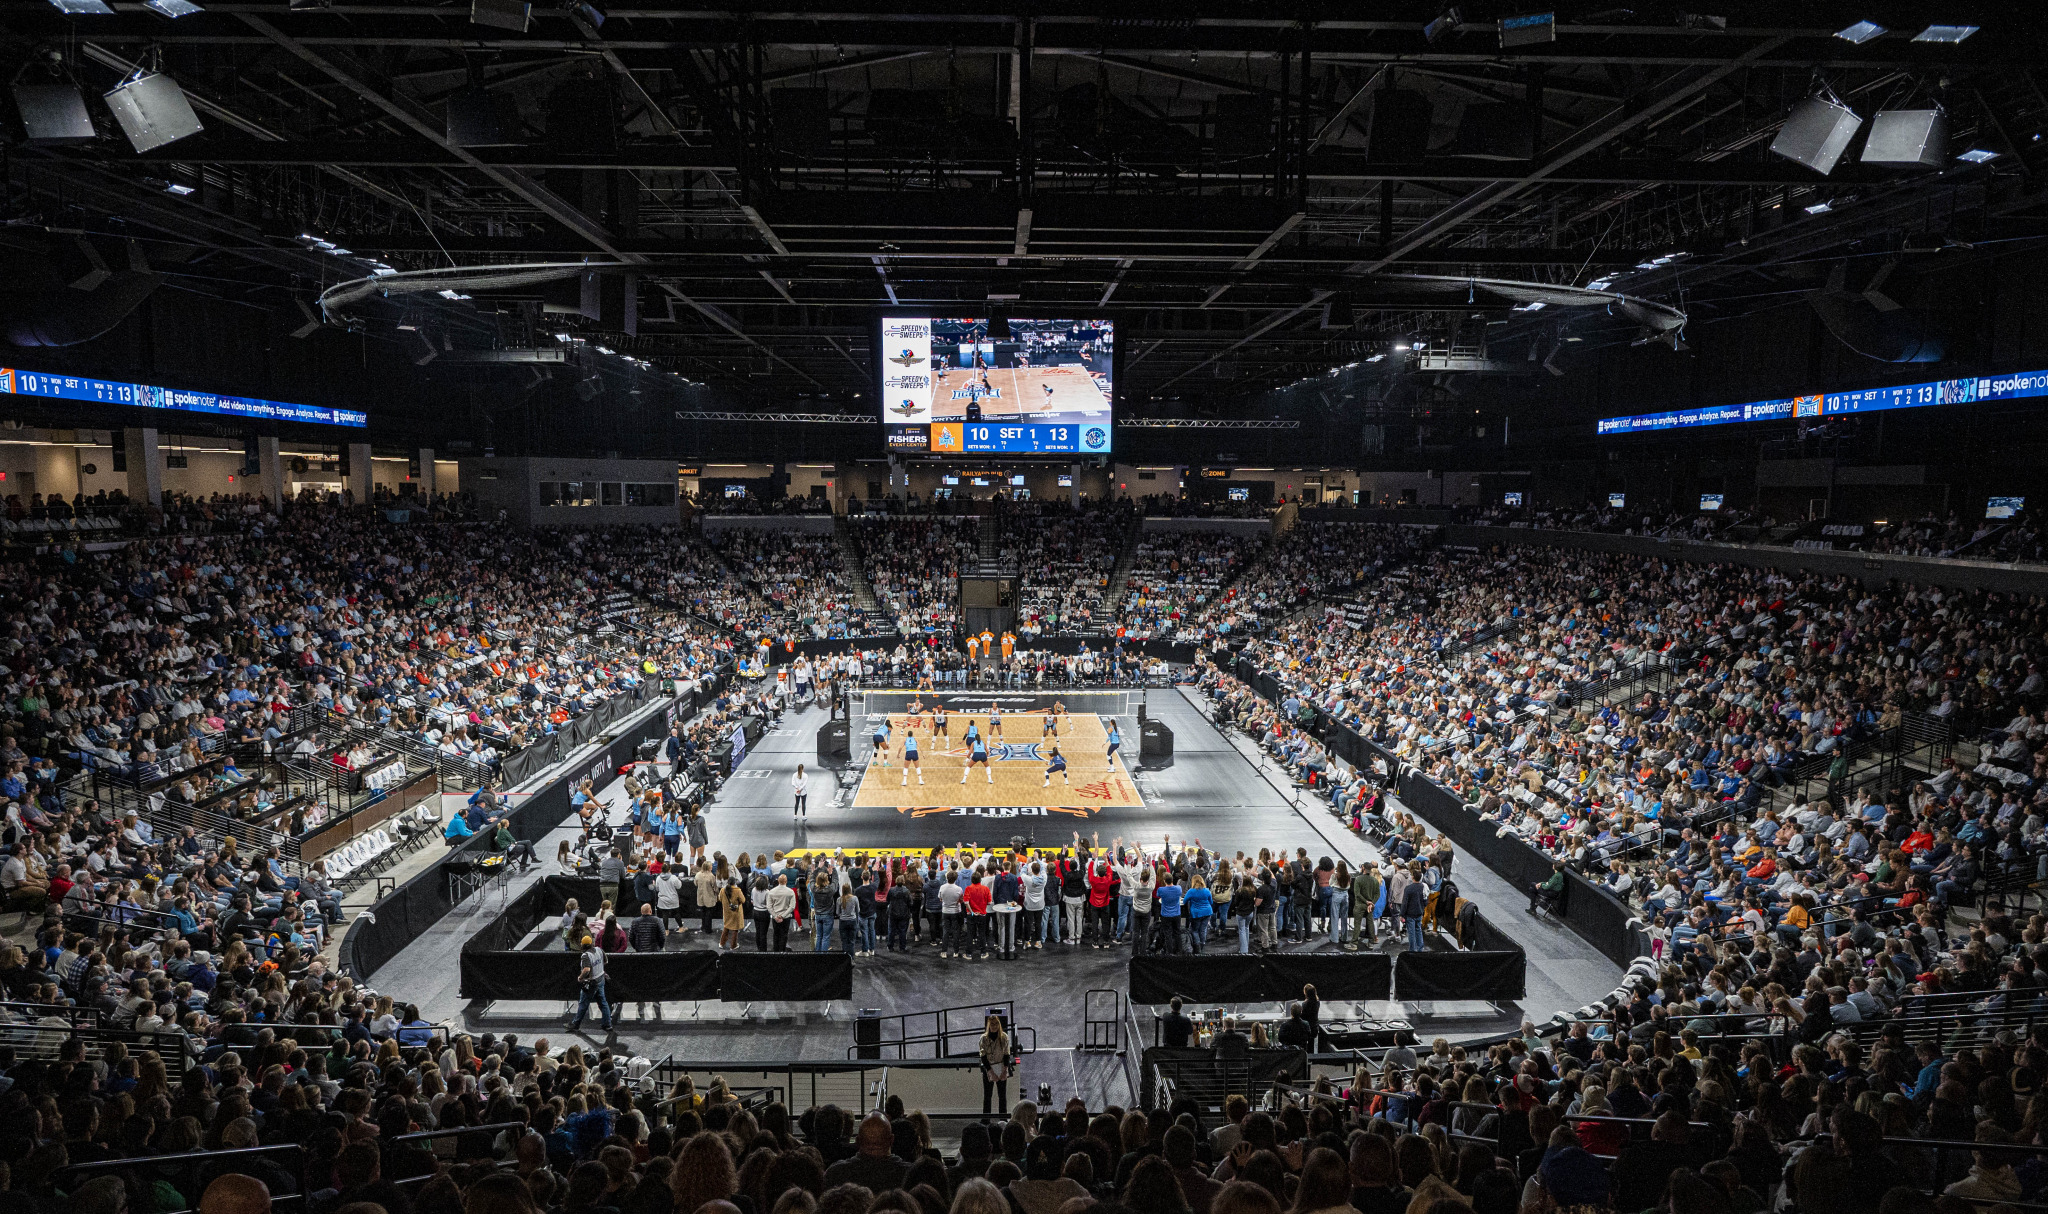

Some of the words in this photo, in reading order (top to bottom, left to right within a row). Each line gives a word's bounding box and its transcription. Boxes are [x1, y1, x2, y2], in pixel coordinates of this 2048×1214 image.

[20, 375, 36, 392] 10
[43, 385, 48, 393] 1
[66, 378, 78, 388] SET
[84, 381, 88, 390] 1
[54, 386, 59, 394] 0
[98, 390, 102, 399] 0
[108, 392, 113, 400] 2
[118, 386, 131, 401] 13
[1864, 391, 1878, 400] SET
[1918, 387, 1933, 403] 13
[174, 392, 215, 406] spokenote
[1827, 396, 1840, 411] 10
[1854, 401, 1858, 409] 0
[1895, 397, 1899, 405] 0
[1906, 396, 1911, 404] 2
[218, 400, 230, 409] Add
[231, 402, 245, 410] video
[253, 404, 275, 416] anything.
[276, 407, 295, 417] Engage.
[296, 409, 314, 419] Analyze.
[314, 410, 331, 420] Repeat.
[1752, 402, 1792, 417] spokenote
[340, 411, 366, 423] spokenote
[1641, 418, 1652, 426] video
[1658, 416, 1678, 426] anything.
[1679, 415, 1698, 424] Engage.
[1699, 413, 1719, 422] Analyze.
[1720, 410, 1740, 420] Repeat.
[1604, 419, 1630, 431] spokenote
[970, 428, 988, 441] 10
[1000, 428, 1024, 439] SET
[1029, 428, 1035, 439] 1
[1049, 428, 1068, 441] 13
[591, 760, 605, 780] WRTV
[950, 807, 1048, 816] IGNITE
